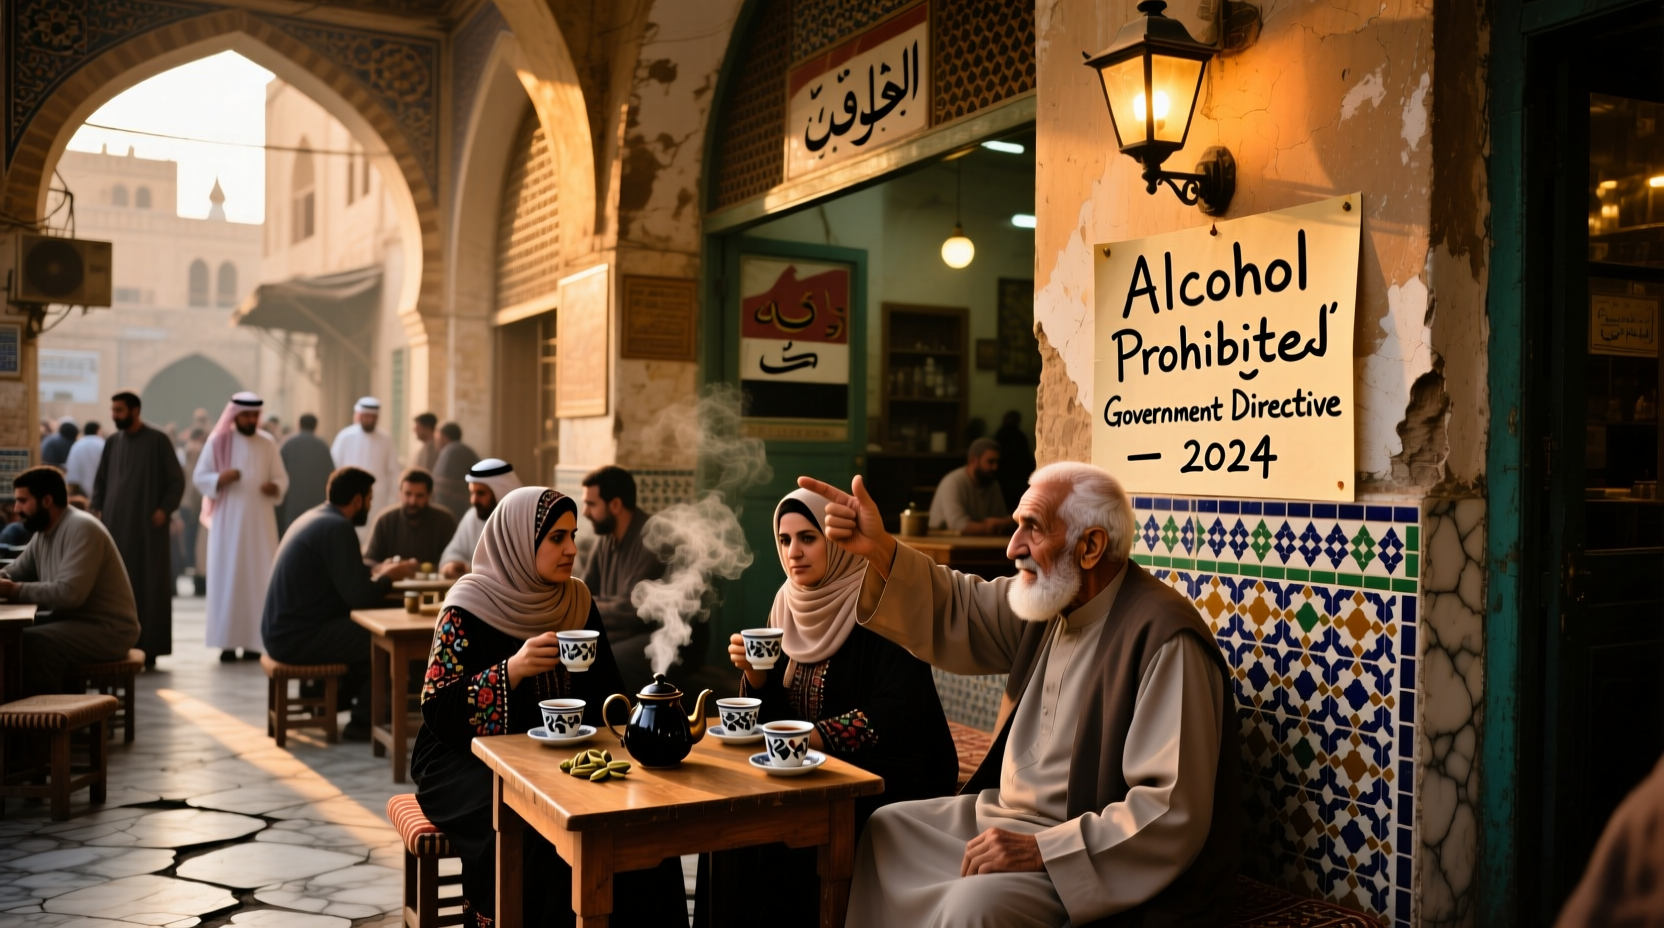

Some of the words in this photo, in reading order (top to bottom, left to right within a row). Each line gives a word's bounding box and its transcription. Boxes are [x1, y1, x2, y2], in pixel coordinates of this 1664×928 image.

[1122, 228, 1307, 319] Alcohol
[1103, 394, 1224, 428] Government
[1231, 388, 1342, 422] Directive
[1180, 434, 1278, 480] 2024
